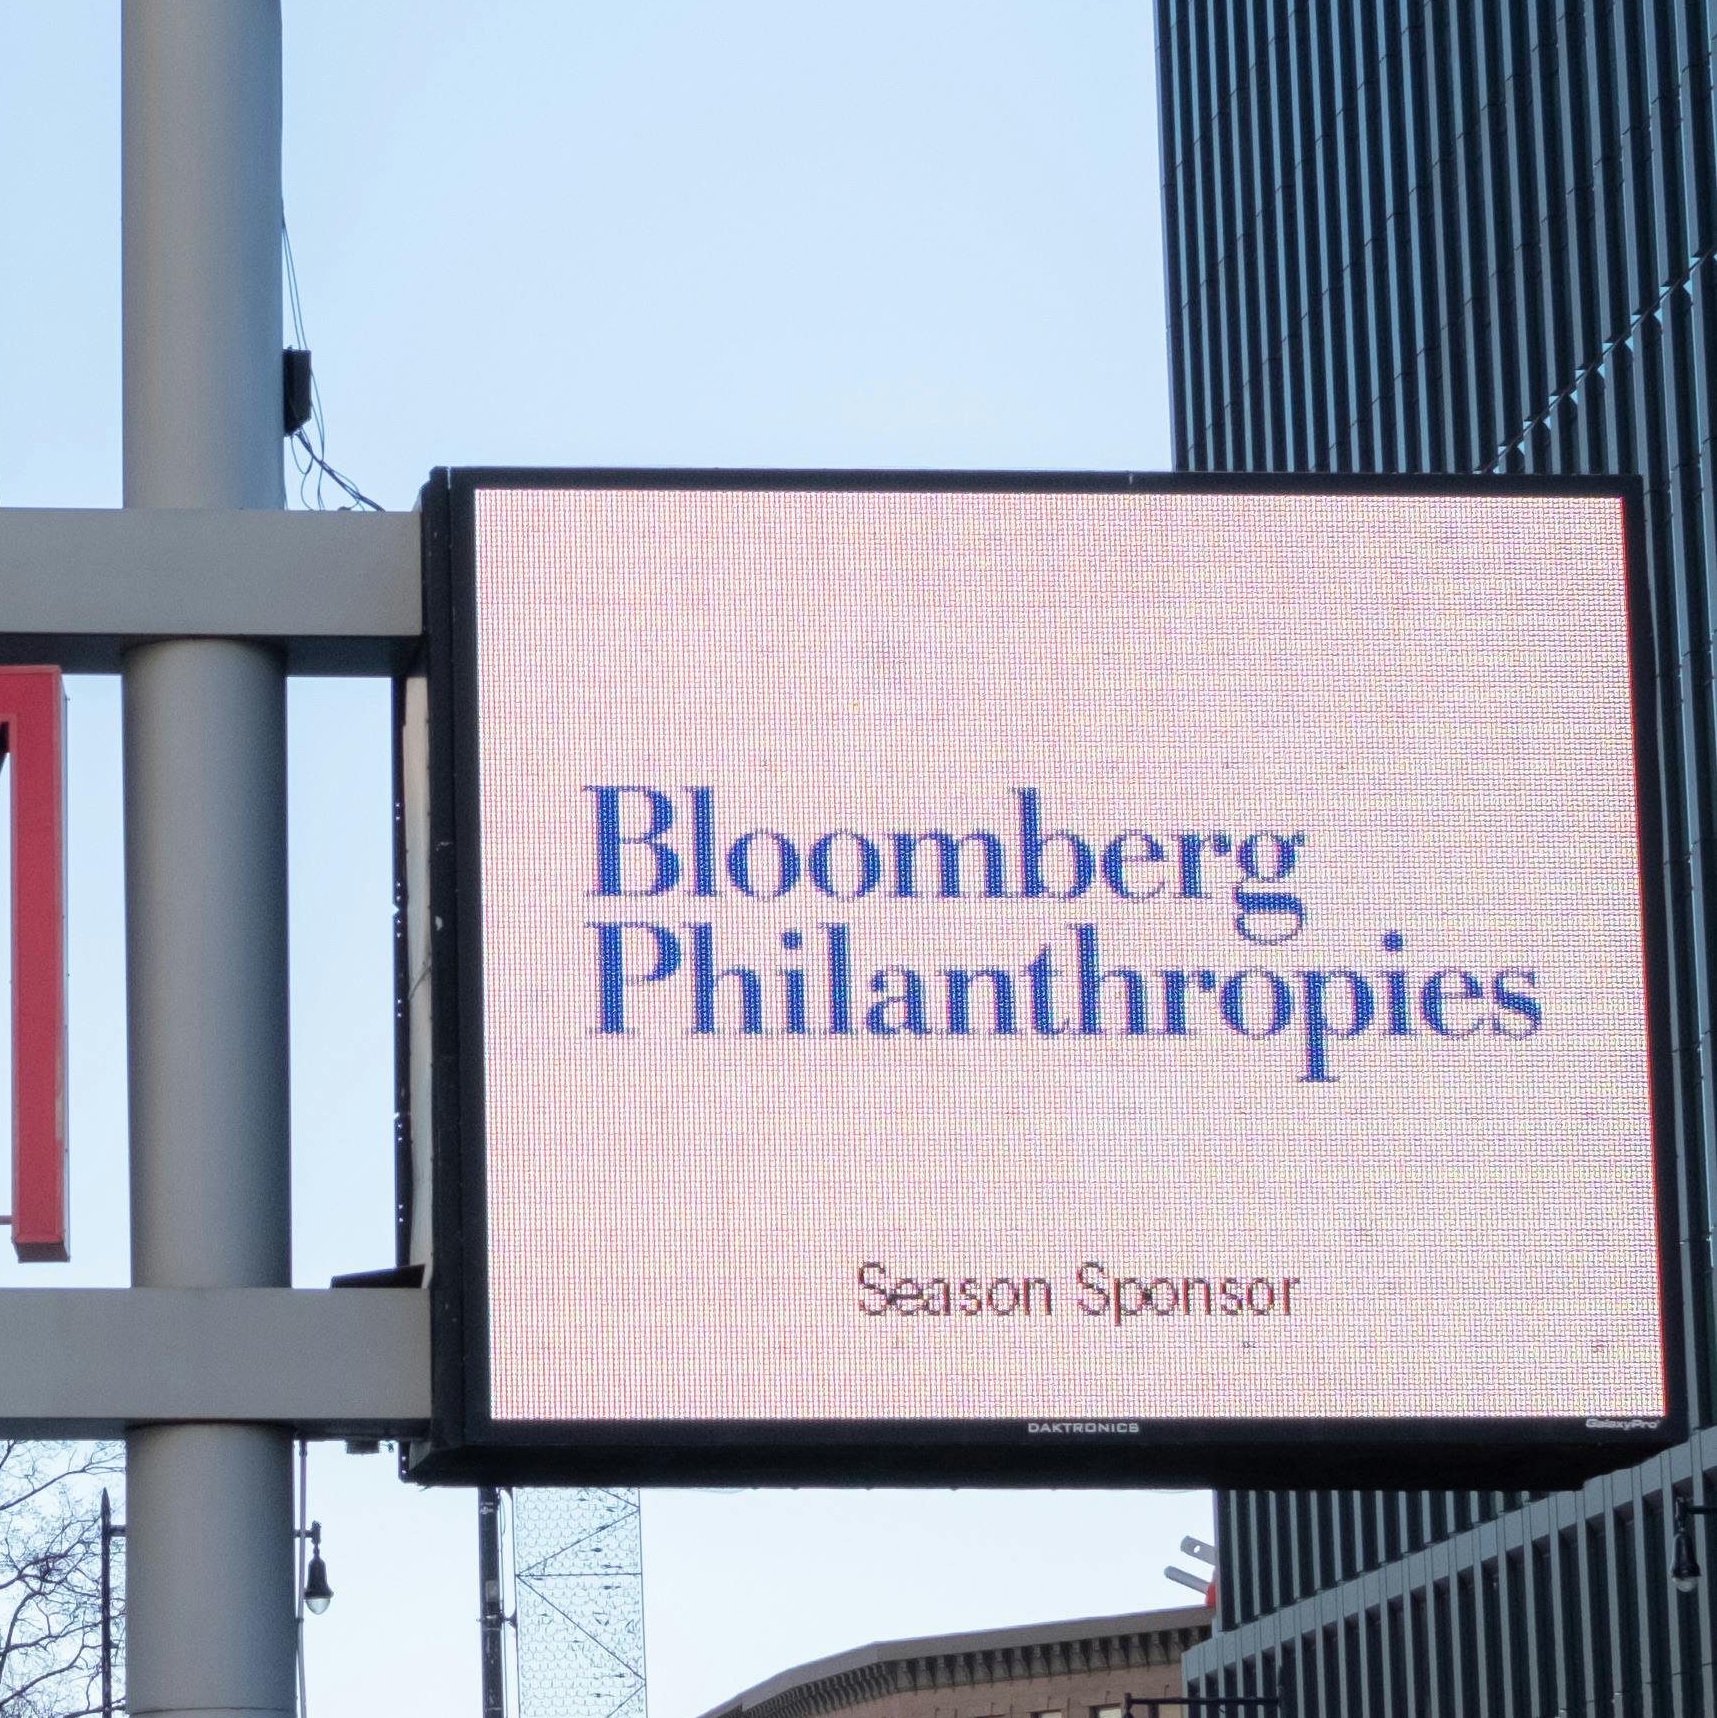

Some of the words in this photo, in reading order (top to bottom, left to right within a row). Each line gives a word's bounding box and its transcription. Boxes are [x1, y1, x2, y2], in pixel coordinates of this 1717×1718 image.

[582, 784, 1307, 947] Bloomberg
[584, 921, 1543, 1084] Philanthropies
[858, 1260, 1053, 1317] Season
[1077, 1260, 1301, 1326] Sponsor
[1027, 1422, 1140, 1434] DAKTRONICS
